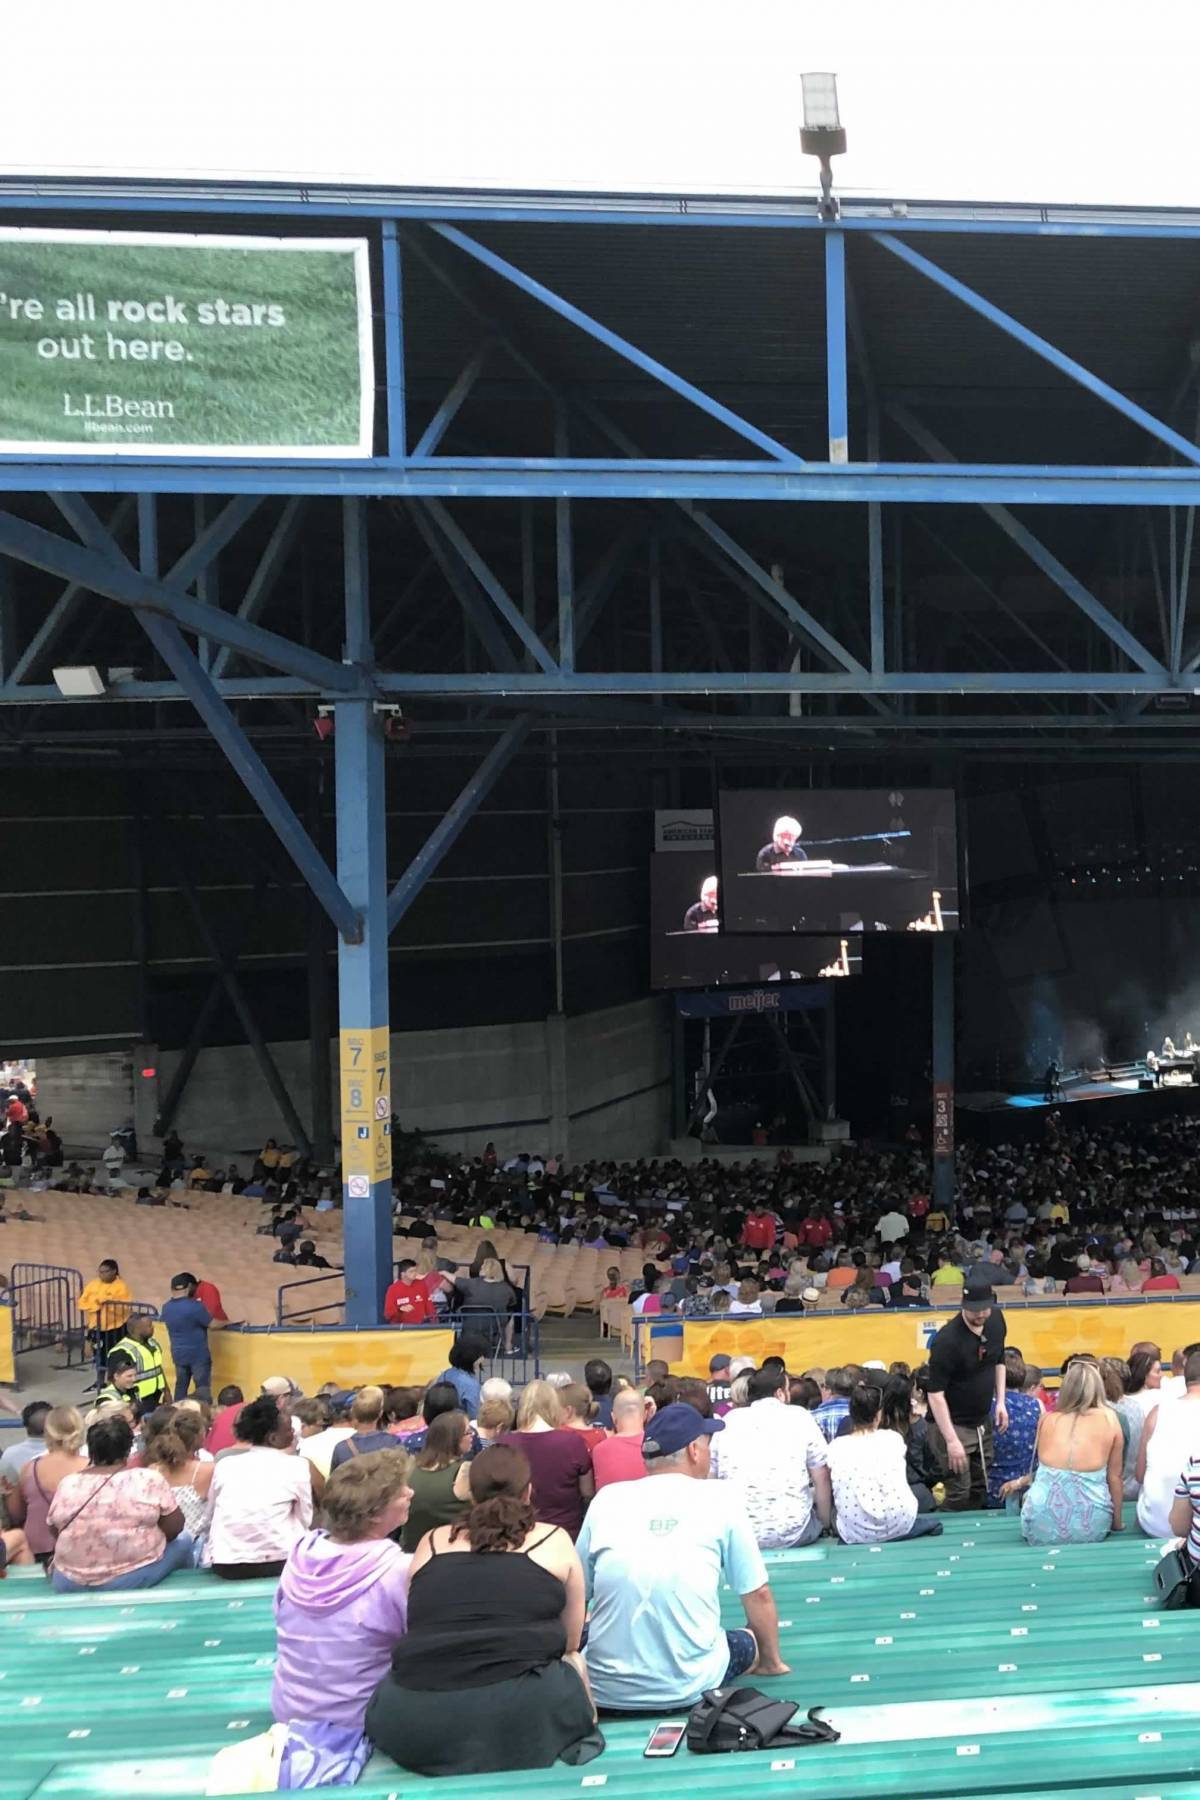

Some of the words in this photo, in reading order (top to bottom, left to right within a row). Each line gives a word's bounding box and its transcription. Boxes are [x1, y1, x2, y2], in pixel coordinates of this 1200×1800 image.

[56, 293, 95, 321] all
[108, 296, 189, 325] rock
[198, 298, 286, 326] stars
[37, 333, 95, 360] out
[107, 332, 194, 361] here.
[350, 1047, 362, 1066] 7
[376, 1067, 386, 1091] 7
[351, 1088, 362, 1107] 8
[938, 1100, 946, 1113] 3
[923, 1329, 937, 1350] 7
